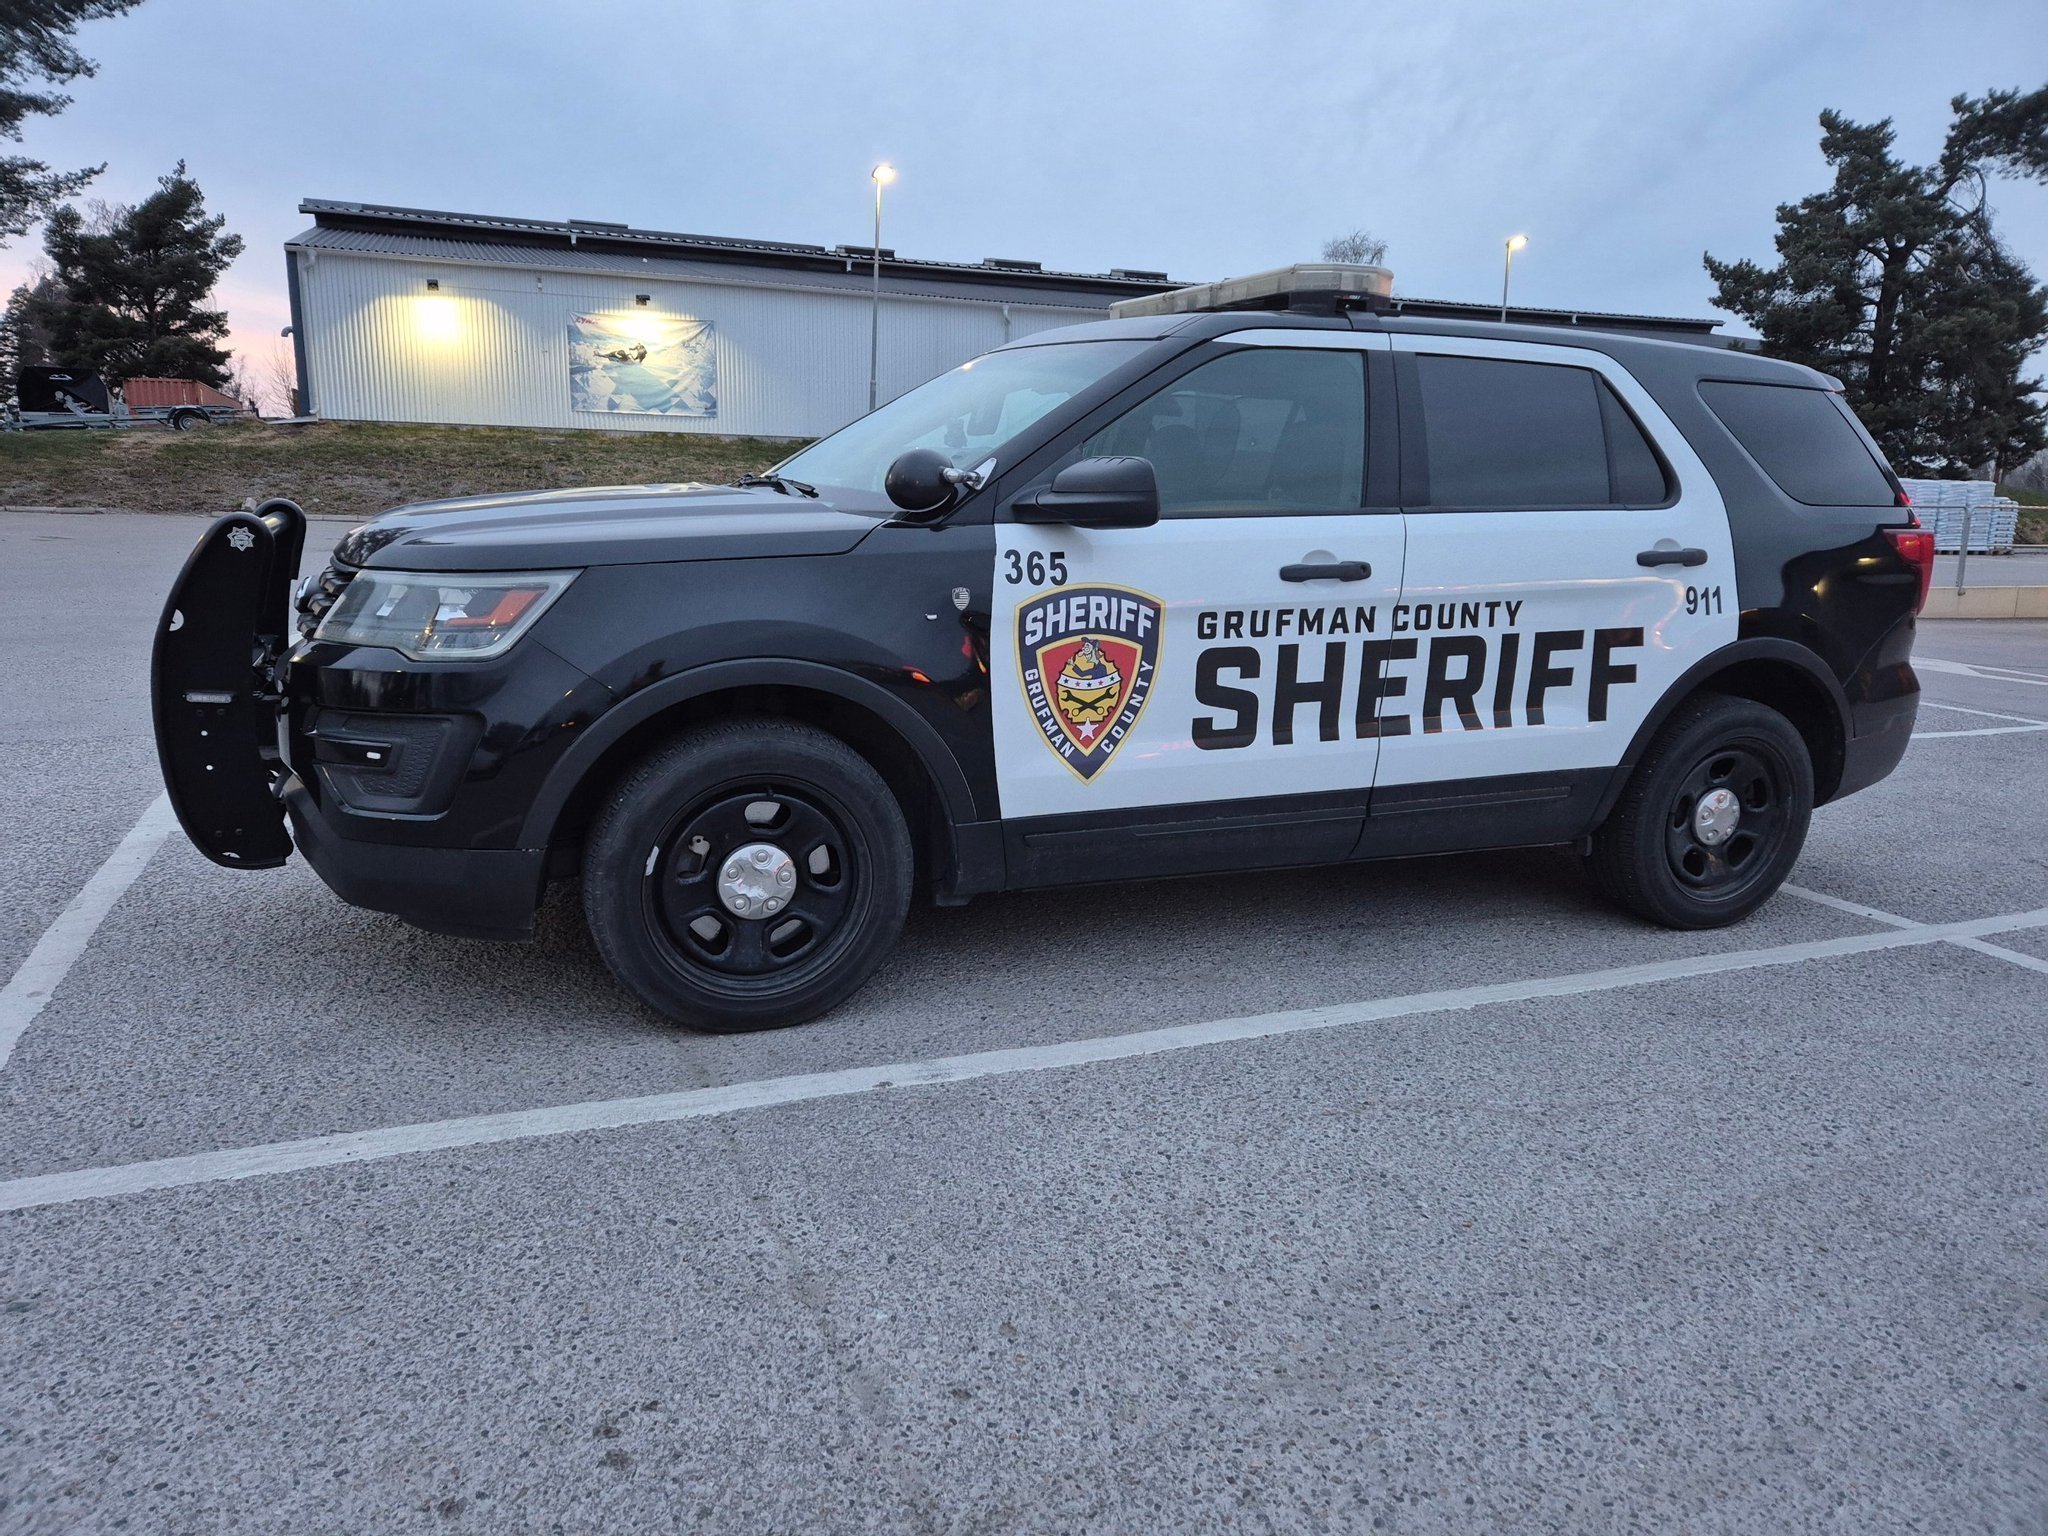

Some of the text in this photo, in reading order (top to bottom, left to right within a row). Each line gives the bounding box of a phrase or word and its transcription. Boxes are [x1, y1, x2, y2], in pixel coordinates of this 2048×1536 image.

[1004, 549, 1068, 586] 365
[1025, 596, 1154, 646] SHERIFF
[1197, 600, 1523, 640] GRUFMAN COUNTY
[1686, 586, 1722, 615] 911
[1024, 661, 1153, 758] GRUFMAN COUNTY
[1192, 627, 1644, 750] SHERIFF
